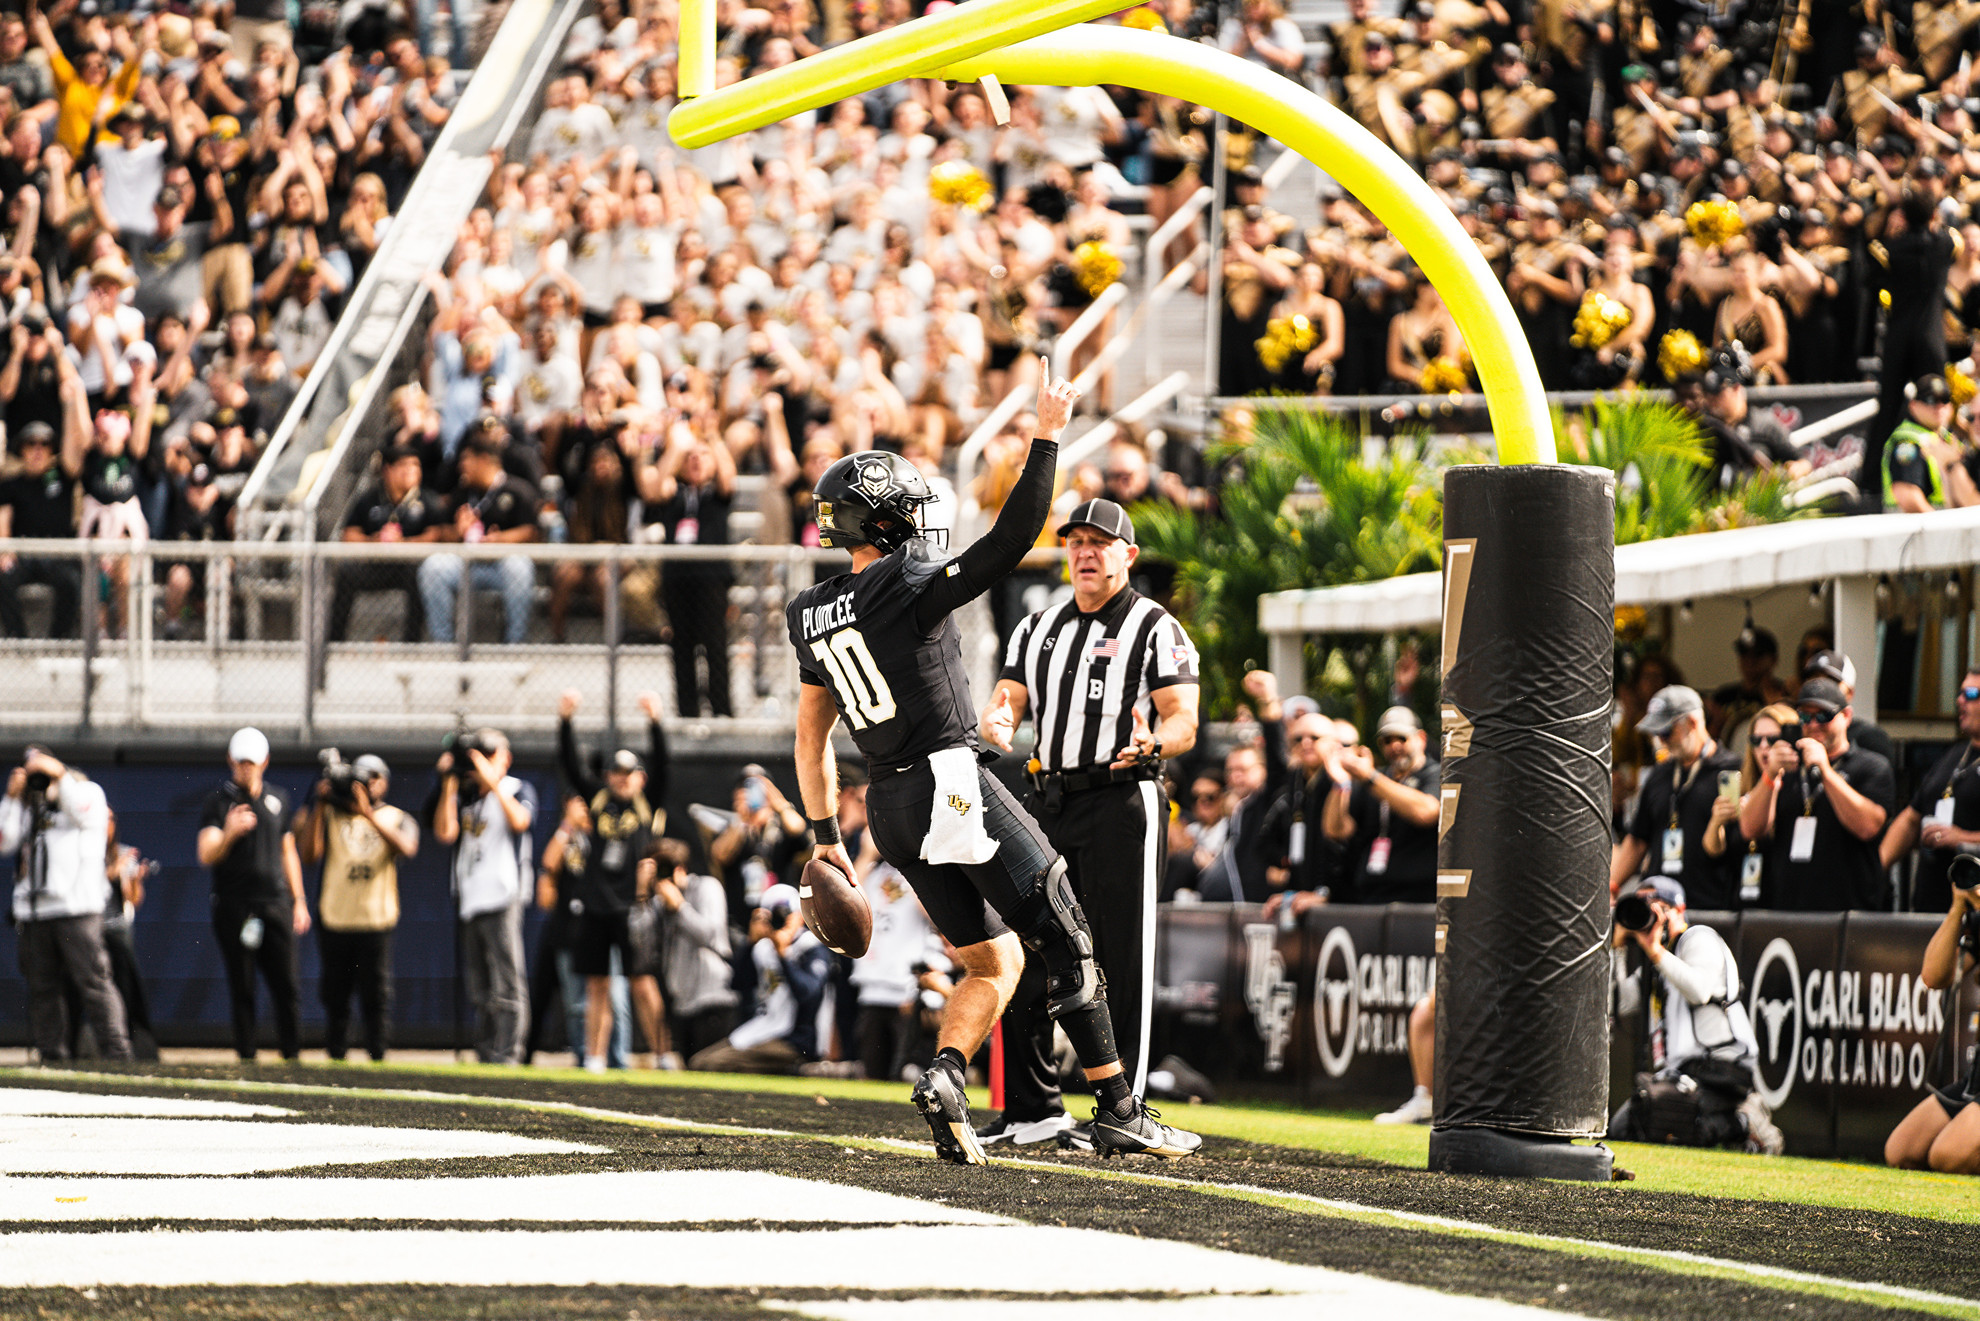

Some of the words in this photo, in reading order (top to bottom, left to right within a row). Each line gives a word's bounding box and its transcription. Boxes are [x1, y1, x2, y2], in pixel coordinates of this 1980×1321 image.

[809, 626, 898, 732] 10
[1088, 678, 1105, 700] B
[947, 794, 972, 817] UCF
[1804, 968, 1864, 1031] CARL
[1868, 971, 1945, 1034] BLACK
[1356, 1010, 1408, 1053] ORLA
[1801, 1036, 1926, 1090] ORLANDO
